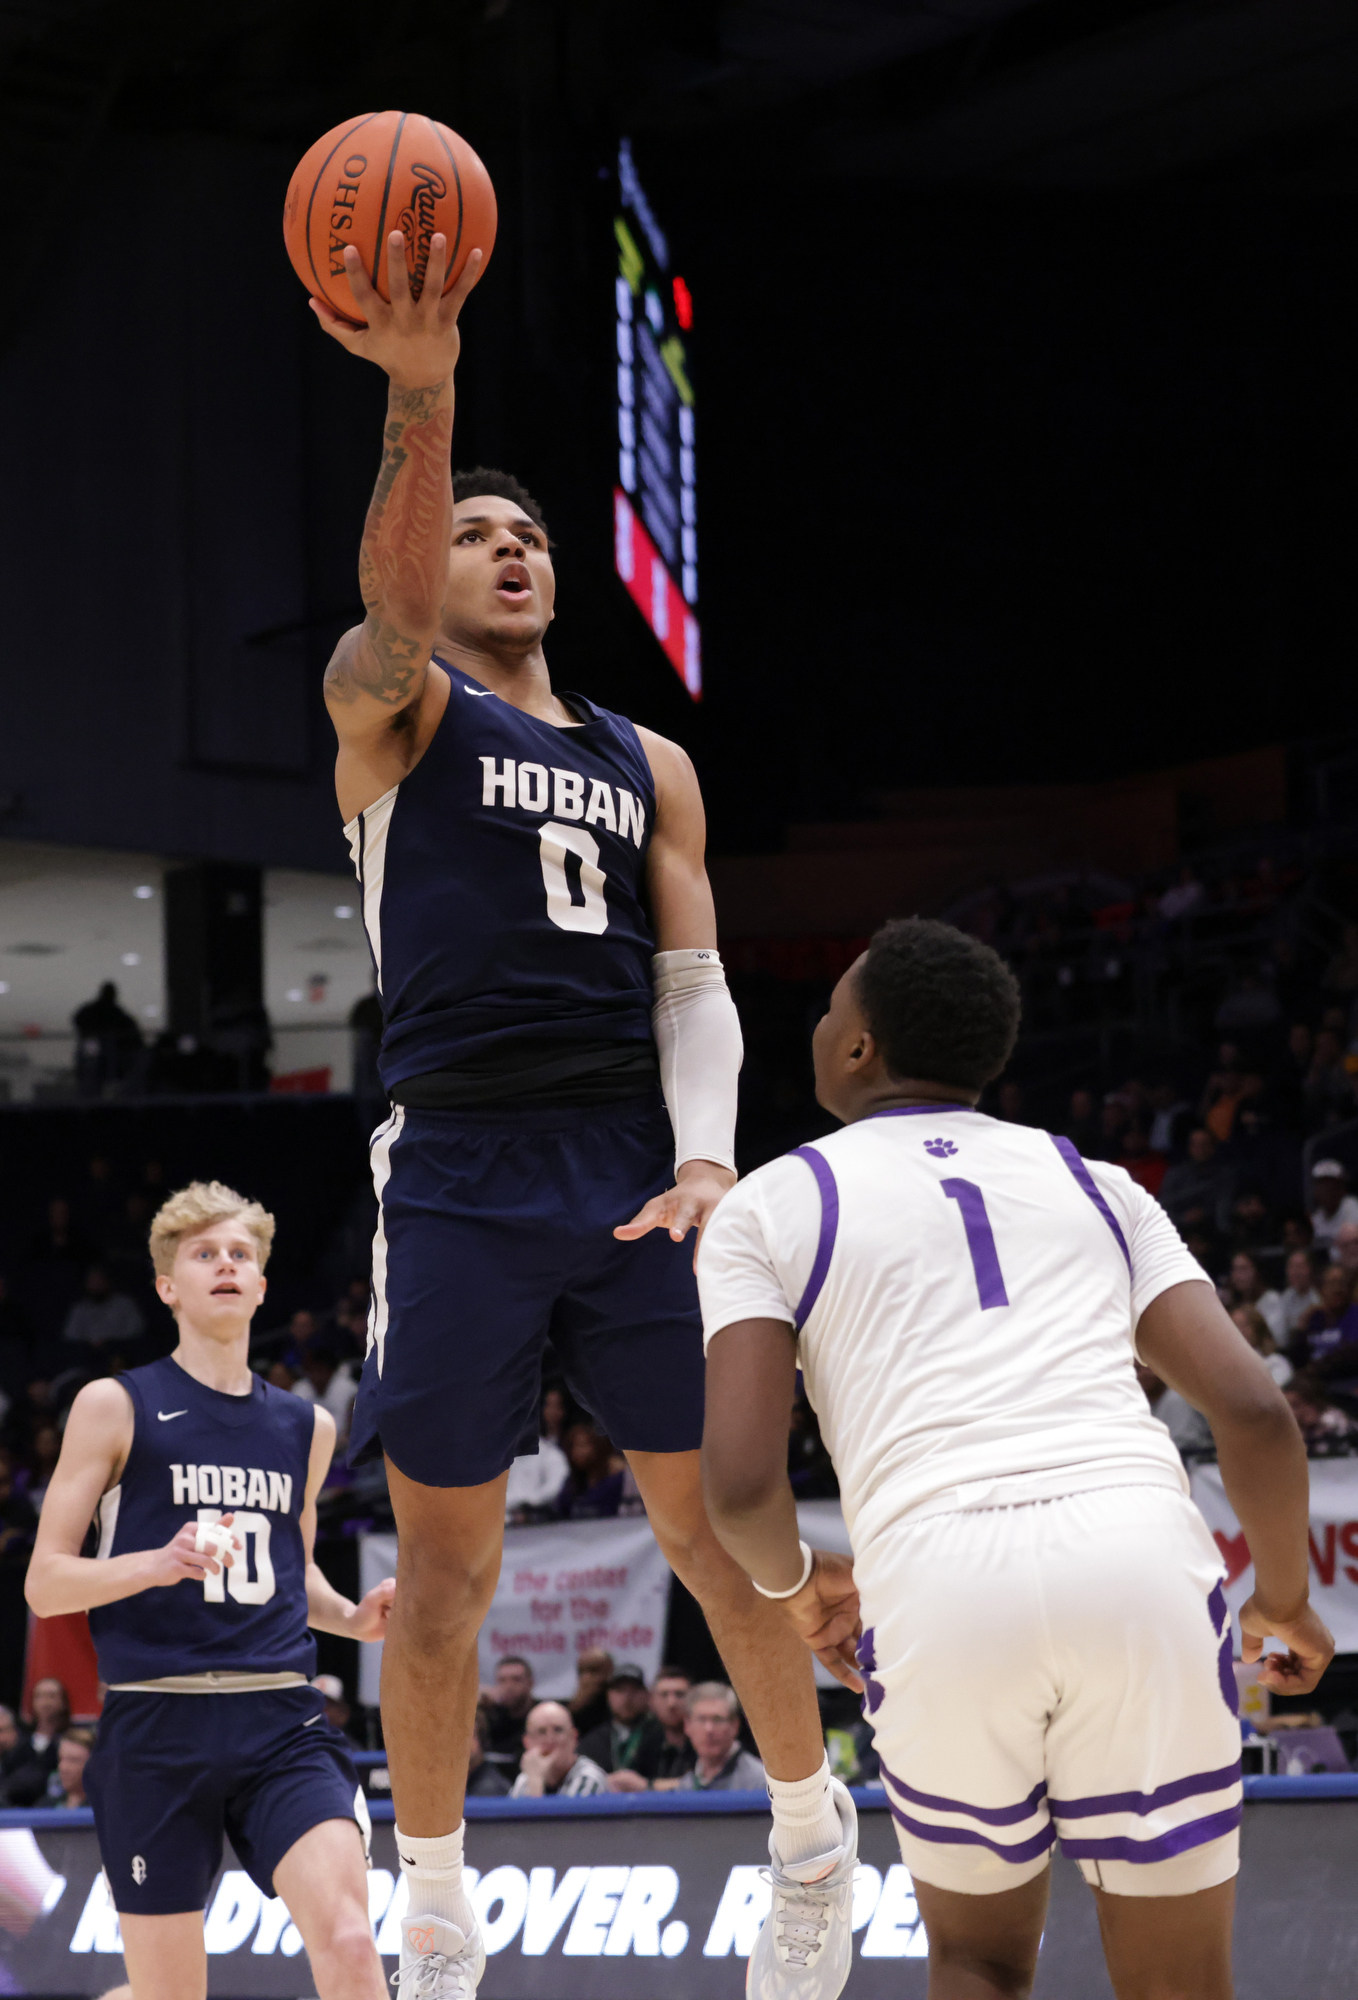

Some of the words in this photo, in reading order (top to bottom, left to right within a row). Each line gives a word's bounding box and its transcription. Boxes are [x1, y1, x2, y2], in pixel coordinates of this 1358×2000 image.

[328, 154, 368, 278] OHSAA
[478, 756, 646, 850] HOBAN
[537, 820, 609, 936] 0
[939, 1177, 1010, 1312] 1
[168, 1463, 293, 1515] HOBAN
[196, 1508, 276, 1606] 10
